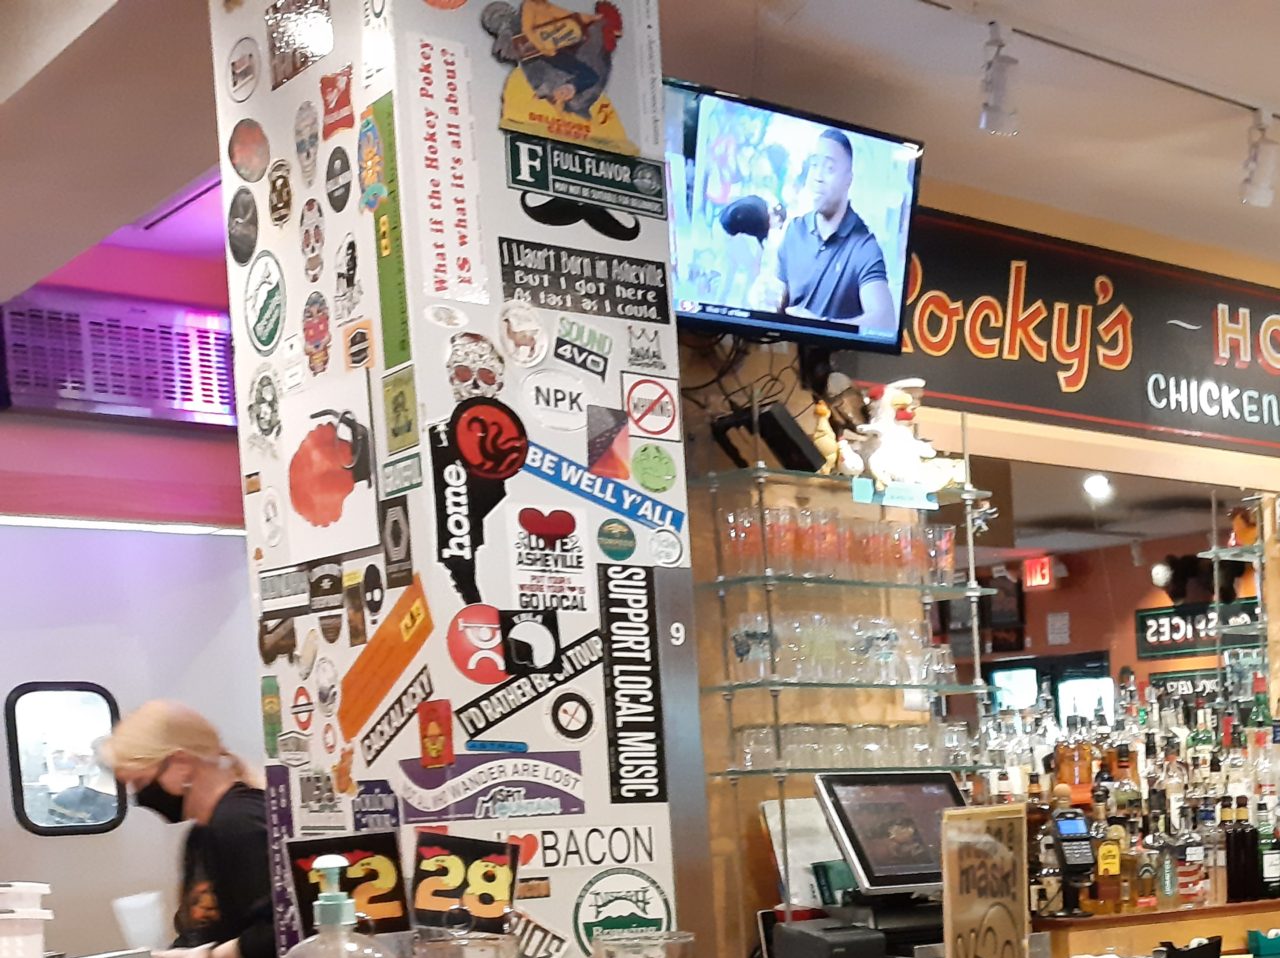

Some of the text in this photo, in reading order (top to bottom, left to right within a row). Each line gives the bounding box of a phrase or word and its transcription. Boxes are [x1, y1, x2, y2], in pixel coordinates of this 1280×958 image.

[418, 39, 434, 100] Pokey
[440, 48, 459, 116] about?
[424, 107, 440, 170] Hokey
[446, 123, 461, 150] all
[515, 141, 543, 183] F
[553, 149, 632, 185] FULL FLAVOR
[427, 178, 442, 210] the
[453, 196, 468, 248] what
[502, 241, 509, 265] I
[560, 250, 592, 278] Born
[595, 256, 608, 279] in
[539, 290, 572, 307] fast
[604, 299, 611, 313] I
[616, 303, 662, 320] could.
[559, 276, 567, 290] I
[574, 280, 605, 295] got
[615, 284, 658, 303] here
[534, 385, 584, 412] NPK
[1146, 373, 1280, 427] CHICKEN
[527, 444, 677, 533] BE WELL Y'ALL
[441, 462, 472, 561] home
[516, 551, 585, 570] ASHEVILLE
[519, 592, 587, 611] GO LOCAL
[607, 566, 652, 663] SUPPORT
[670, 622, 686, 646] 9
[459, 707, 487, 734] I'D
[480, 677, 533, 721] RATHER
[612, 664, 655, 728] LOCAL
[449, 764, 506, 800] WANDER
[510, 762, 540, 778] ARE
[544, 767, 581, 790] LOST
[617, 731, 659, 798] MUSIC
[540, 826, 654, 868] BACON
[414, 853, 513, 910] 28
[959, 854, 1018, 901] mask!
